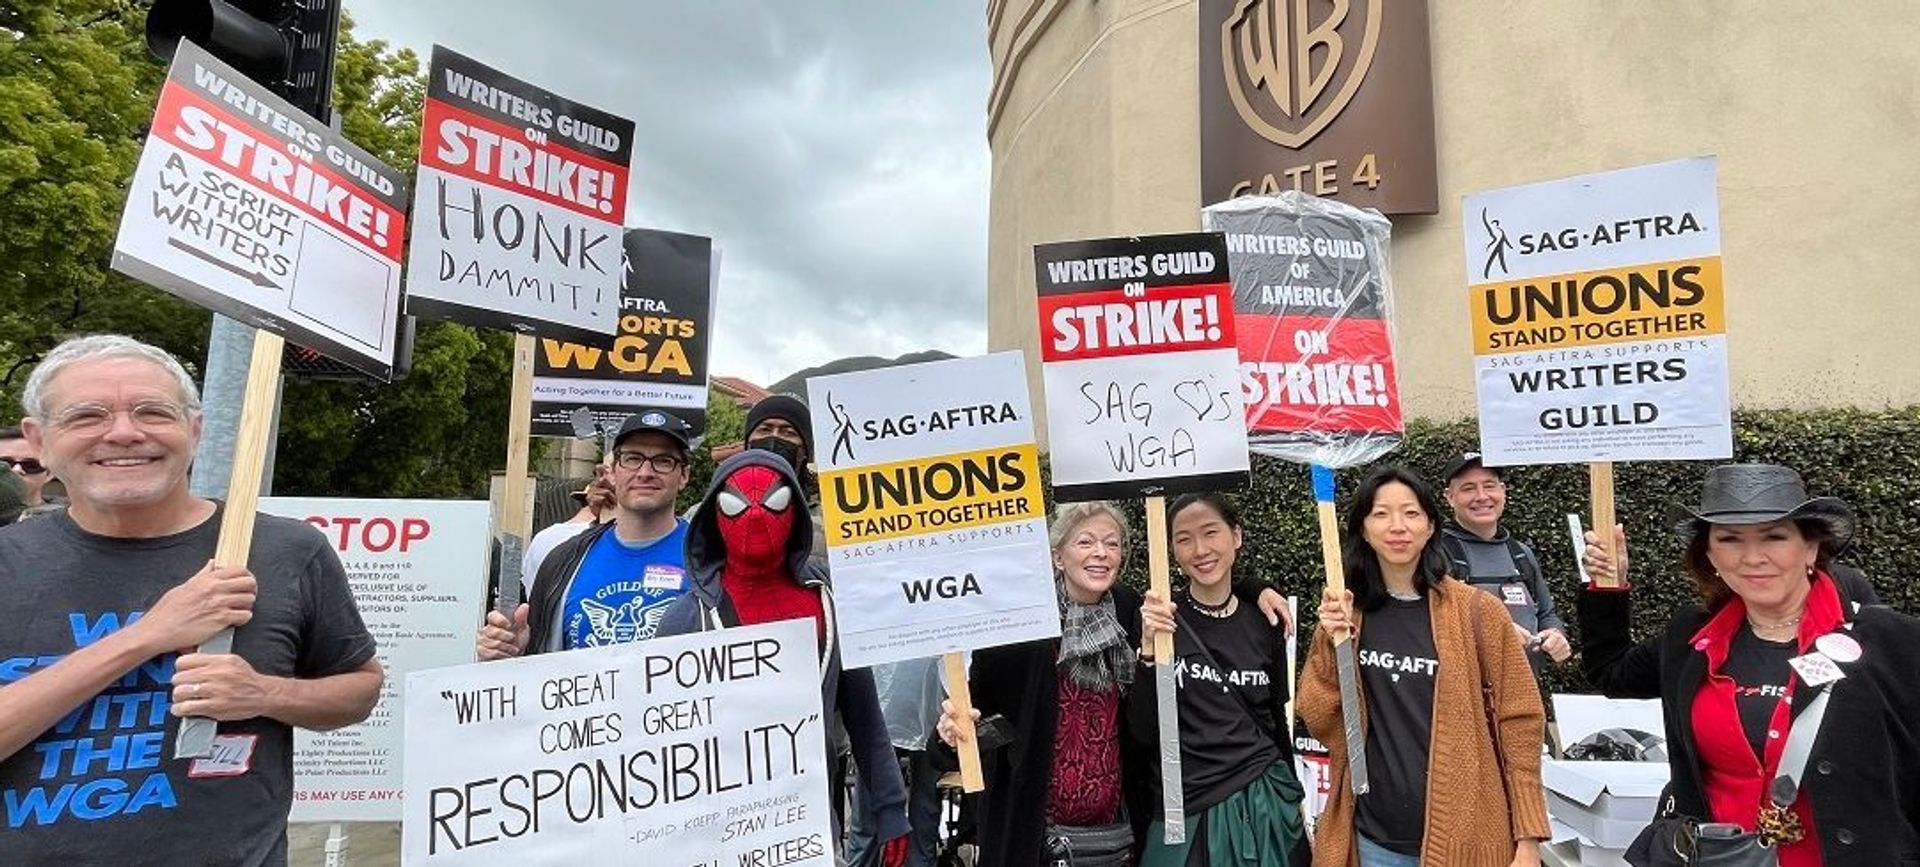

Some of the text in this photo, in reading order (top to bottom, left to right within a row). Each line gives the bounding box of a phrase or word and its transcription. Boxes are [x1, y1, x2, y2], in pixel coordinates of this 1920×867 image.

[195, 63, 395, 197] WRITERS GUILD
[445, 69, 621, 152] WRITERS GUILD
[288, 141, 314, 164] ON
[525, 127, 548, 146] ON
[174, 104, 390, 248] STRIKE!
[437, 119, 615, 215] STRIKE!
[1352, 153, 1381, 189] 4
[159, 170, 293, 246] WITHOUT
[165, 152, 300, 227] A SCRIPT
[152, 191, 291, 277] WRITERS
[437, 176, 610, 275] HONK
[1225, 232, 1367, 259] WRITERS GUILD
[439, 249, 602, 316] DAMMIT!
[1048, 252, 1216, 283] WRITERS GUILD
[1291, 262, 1310, 278] OF
[1124, 282, 1145, 298] ON
[1262, 285, 1346, 308] AMERICA
[1486, 265, 1705, 326] UNIONS
[1052, 294, 1221, 352] STRIKE!
[1295, 330, 1329, 354] ON
[1489, 312, 1707, 348] STAND TOGETHER
[542, 335, 693, 376] WGA
[1508, 358, 1687, 393] WRITERS
[534, 386, 567, 395] Acting
[569, 387, 610, 397] Together
[611, 388, 625, 396] for
[635, 390, 662, 398] Better
[1080, 381, 1153, 426] SAG
[1240, 362, 1390, 408] STRIKE!
[1539, 402, 1659, 430] GUILD
[1106, 428, 1196, 473] WGA
[834, 452, 1026, 513] UNIONS
[840, 498, 1030, 539] STAND TOGETHER
[948, 523, 1034, 545] SUPPORTS
[596, 581, 641, 599] GUILD
[901, 573, 983, 604] WGA
[541, 670, 620, 711] GREAT
[645, 639, 781, 694] POWER
[1359, 649, 1439, 675] SAG·AFT
[540, 696, 716, 754] COMES GREAT
[35, 731, 165, 780] THE
[4, 773, 178, 828] WGA
[311, 791, 338, 801] MAY
[341, 791, 366, 800] USE
[369, 791, 395, 800] ANY
[721, 804, 807, 843] STAN LEE
[737, 833, 824, 867] WRITERS
